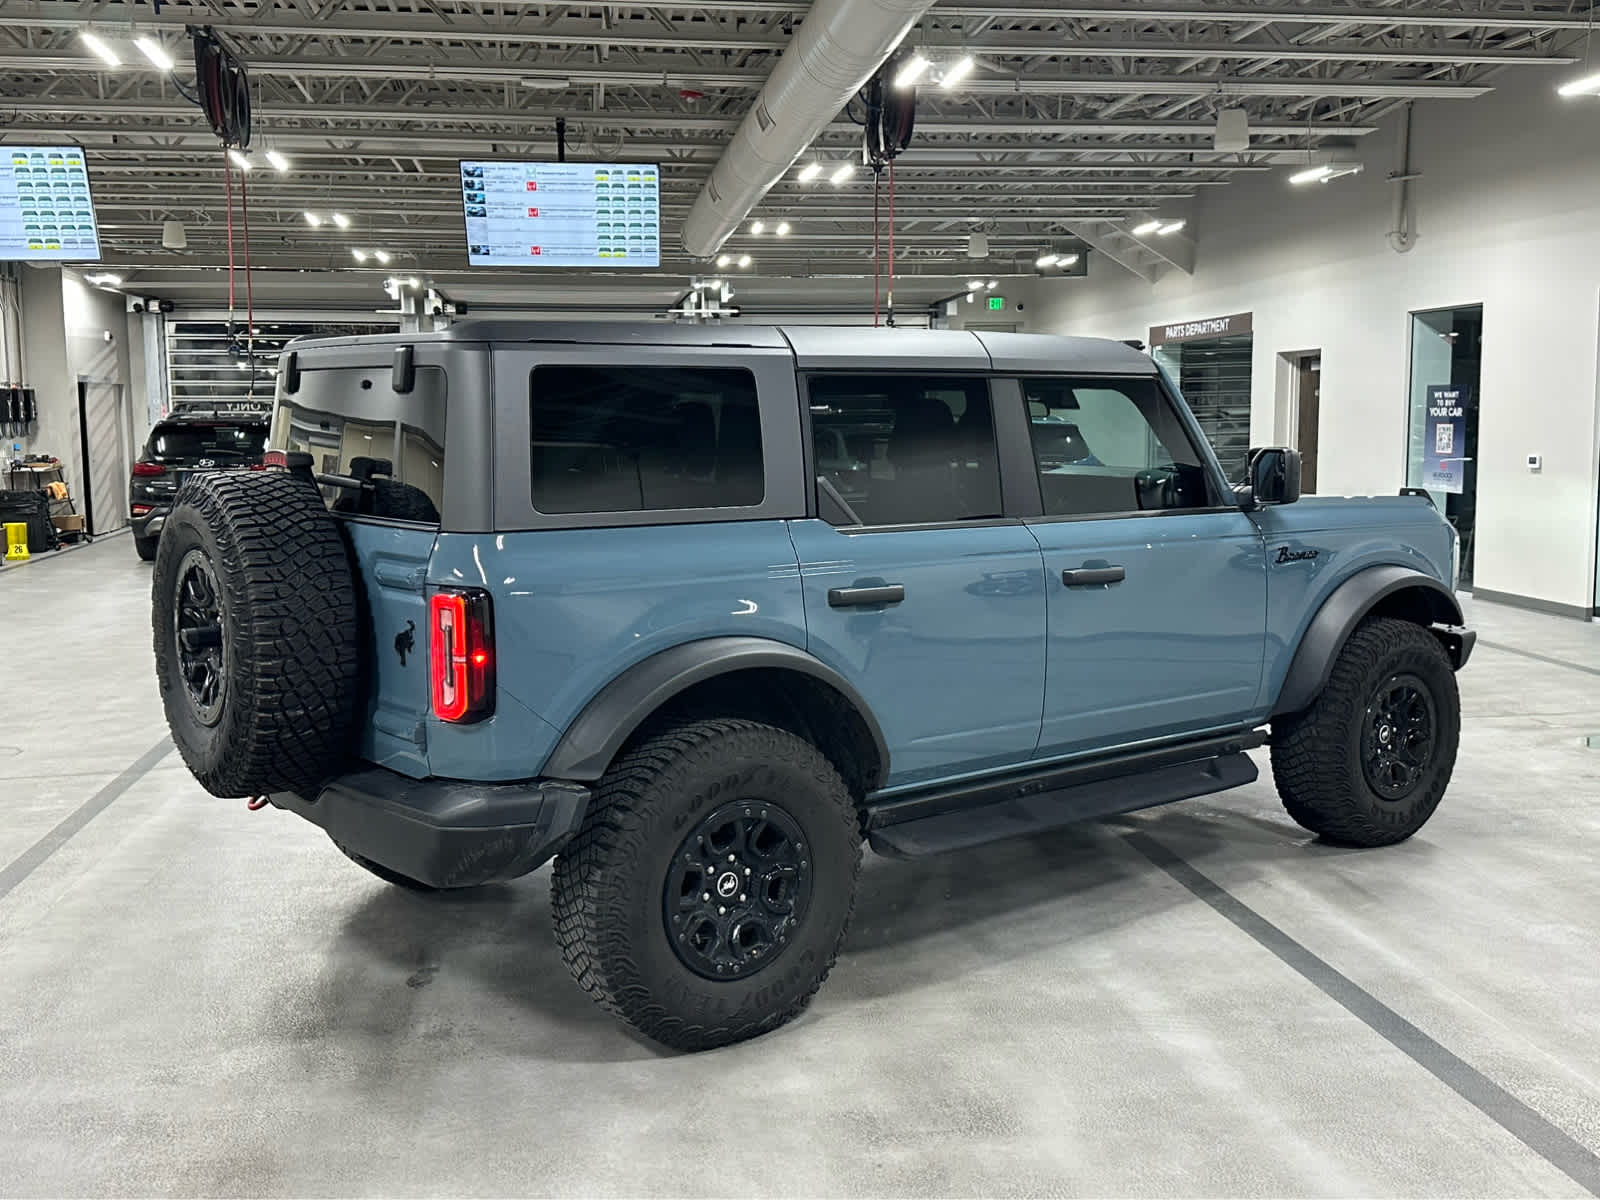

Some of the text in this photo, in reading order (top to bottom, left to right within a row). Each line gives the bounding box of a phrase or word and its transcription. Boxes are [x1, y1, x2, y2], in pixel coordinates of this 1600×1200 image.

[1165, 318, 1231, 340] PARTS DEPARTMENT
[1429, 407, 1463, 417] YOUR CAR
[1275, 546, 1320, 565] Bronco
